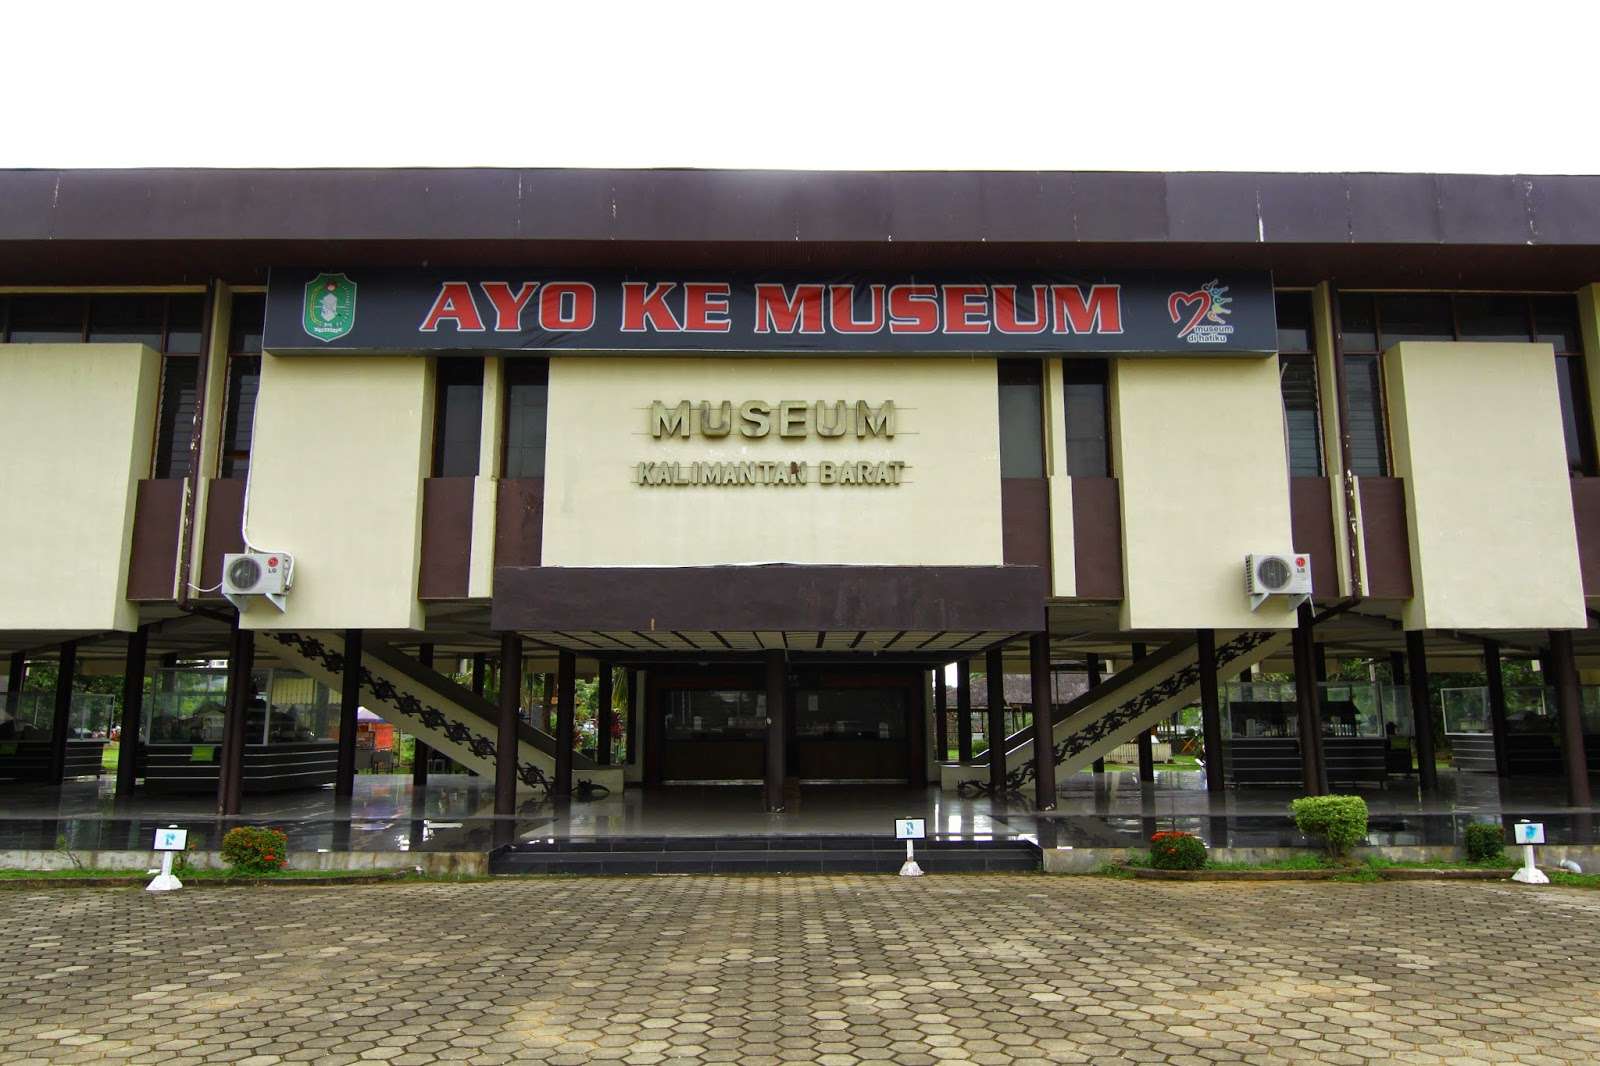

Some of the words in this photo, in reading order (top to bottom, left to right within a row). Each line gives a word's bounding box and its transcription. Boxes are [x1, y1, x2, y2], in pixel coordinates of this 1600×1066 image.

[419, 282, 597, 333] AYO
[620, 282, 732, 333] KE
[753, 283, 1124, 335] MUSEUM
[651, 399, 895, 439] MUSEUM
[637, 460, 808, 486] KALIMANTAN
[819, 460, 905, 486] BARAT
